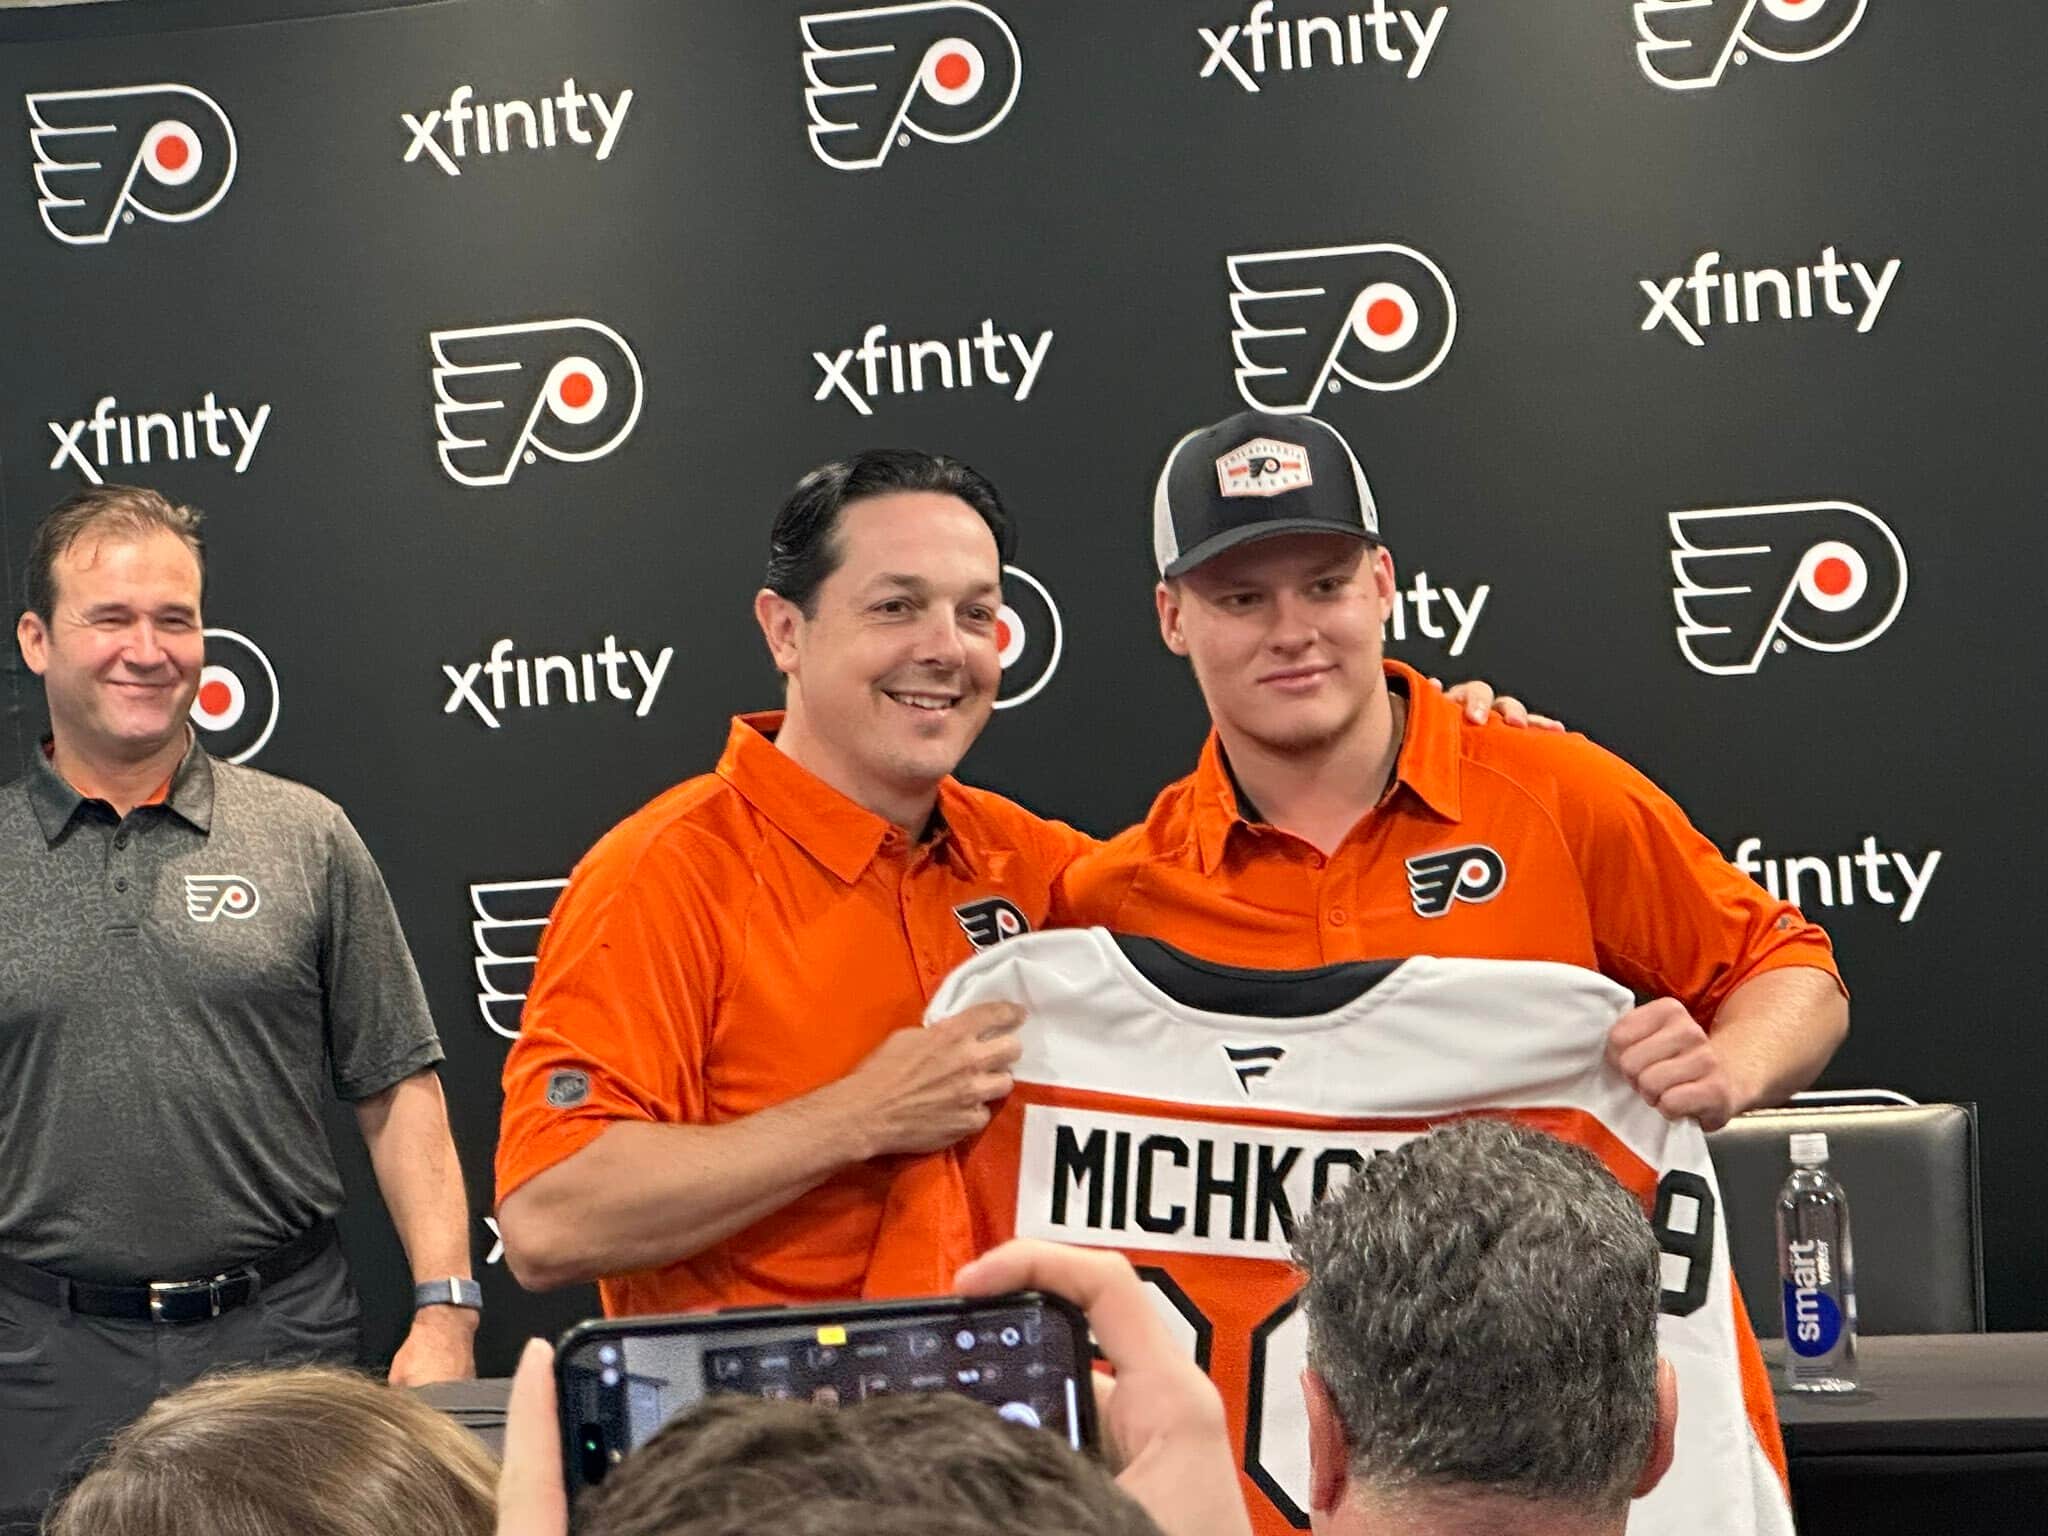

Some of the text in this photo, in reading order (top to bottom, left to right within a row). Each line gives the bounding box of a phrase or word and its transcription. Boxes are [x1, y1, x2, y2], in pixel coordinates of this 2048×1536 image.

[1197, 0, 1449, 93] xfinity
[401, 78, 634, 176] xfinity
[1639, 245, 1901, 346] xfinity
[812, 318, 1054, 416] xfinity
[48, 391, 271, 485] xfinity
[442, 634, 674, 729] xfinity
[1731, 835, 1943, 923] finity
[1050, 1124, 1388, 1243] MICHK
[1788, 1239, 1821, 1342] smart
